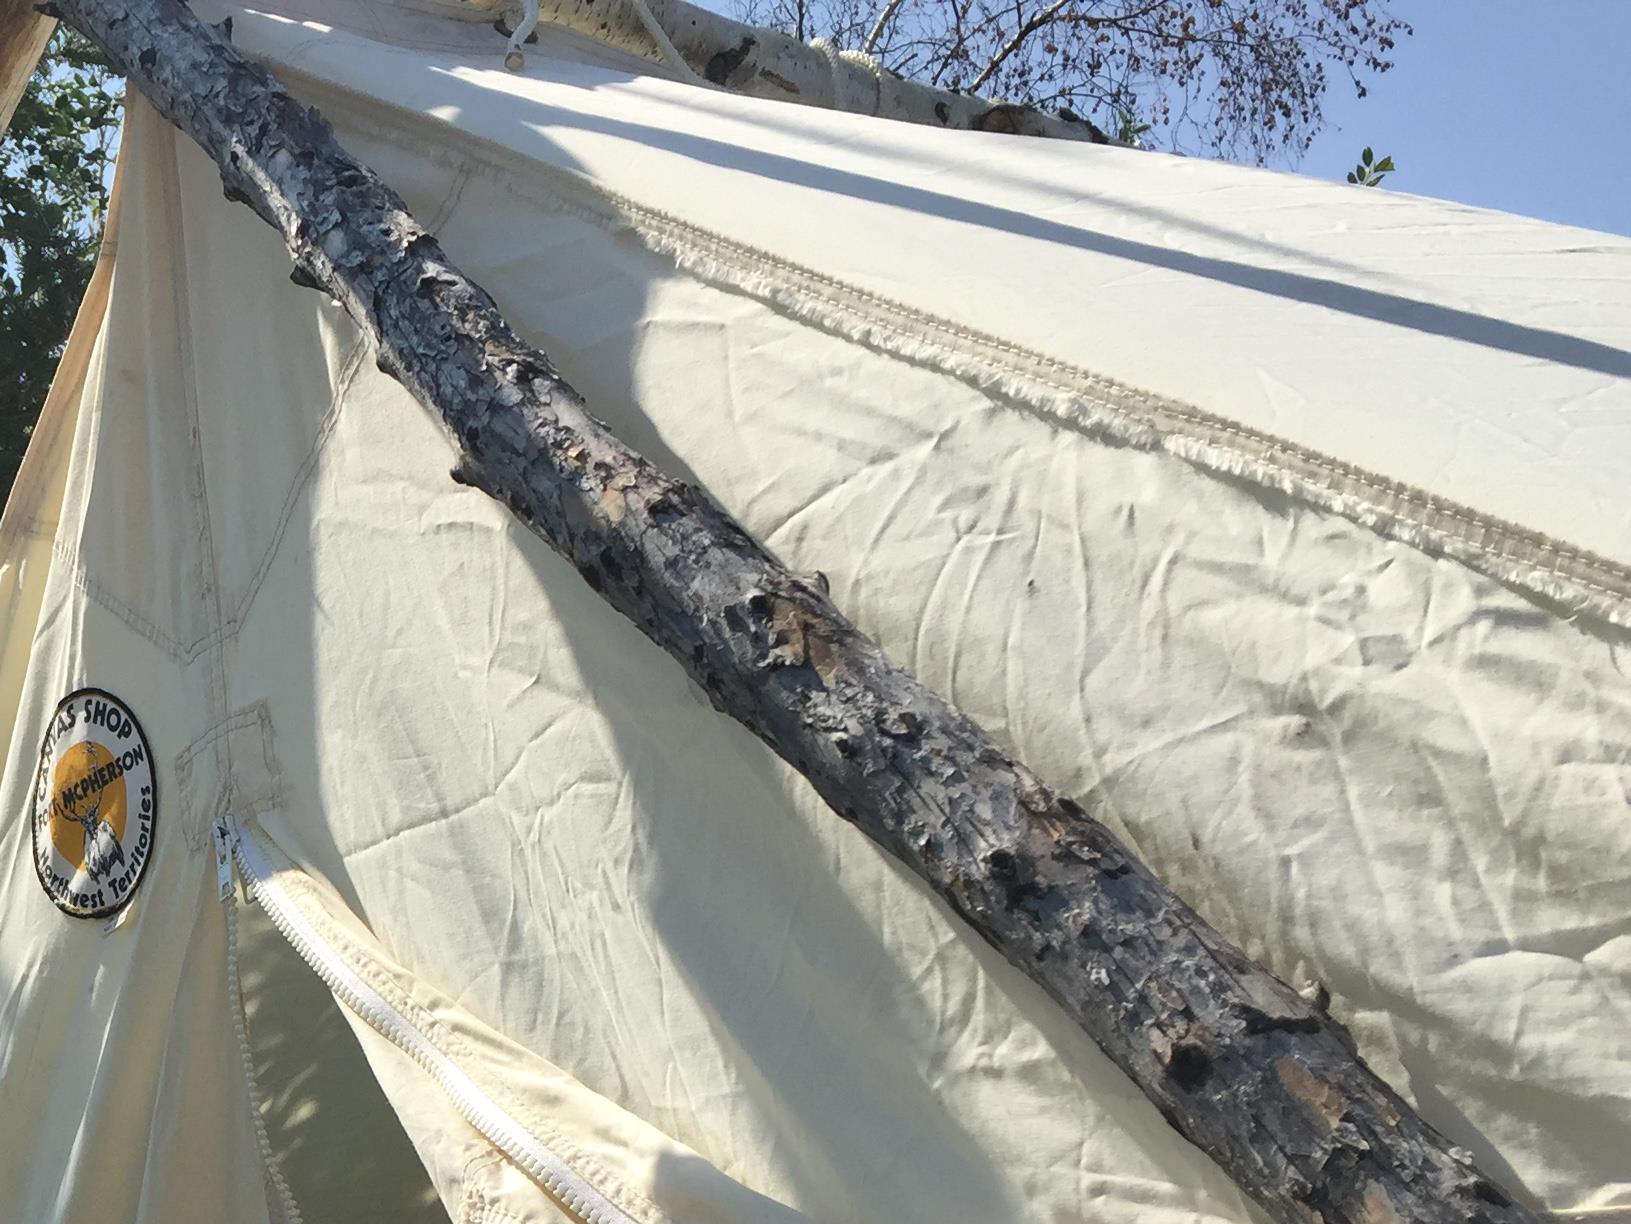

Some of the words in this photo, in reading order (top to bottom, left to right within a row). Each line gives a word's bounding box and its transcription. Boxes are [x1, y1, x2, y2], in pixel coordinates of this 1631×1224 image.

[84, 698, 133, 740] SHOP
[61, 743, 145, 810] MCPHERSON
[39, 846, 106, 909] Northwest
[107, 784, 152, 900] Territories
